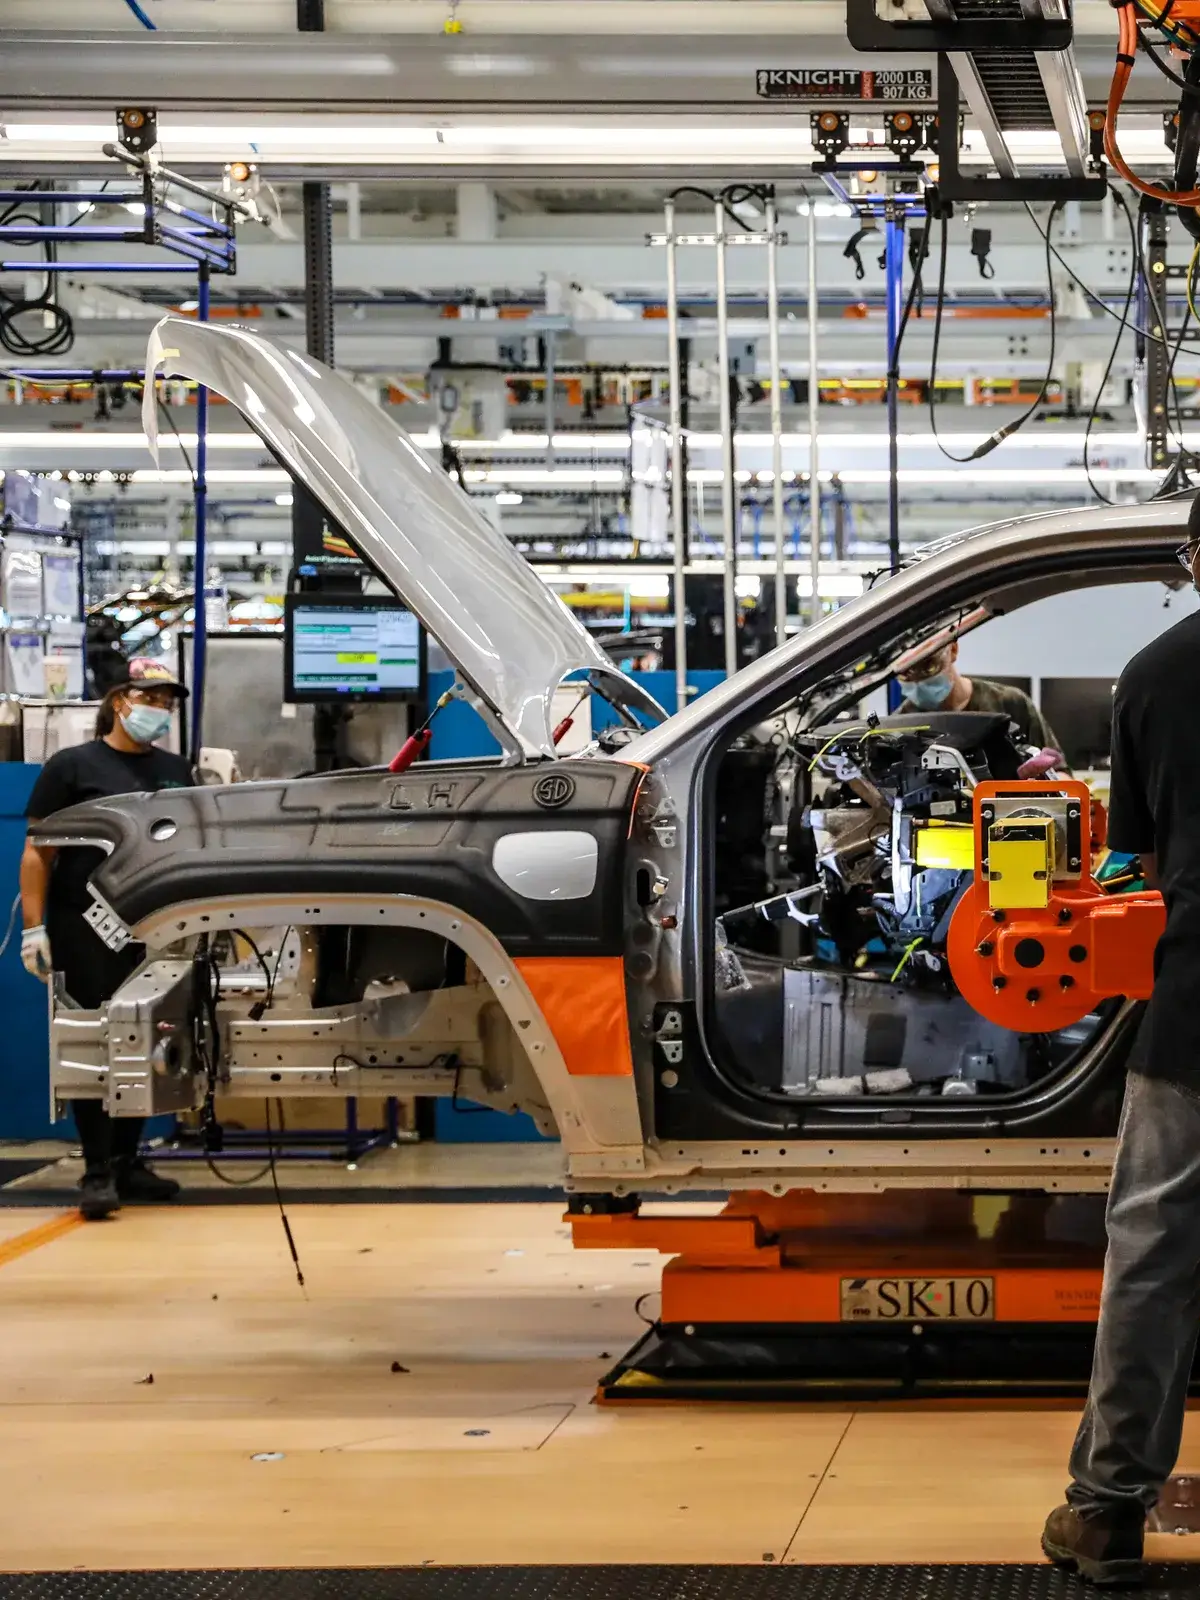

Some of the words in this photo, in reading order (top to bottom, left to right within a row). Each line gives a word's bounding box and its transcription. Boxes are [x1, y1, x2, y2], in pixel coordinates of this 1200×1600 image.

[769, 71, 860, 85] KNIGHT
[875, 71, 904, 84] 2000
[907, 71, 928, 84] LB.
[882, 86, 903, 98] 907
[907, 86, 931, 98] KG.
[877, 1280, 990, 1318] SK10
